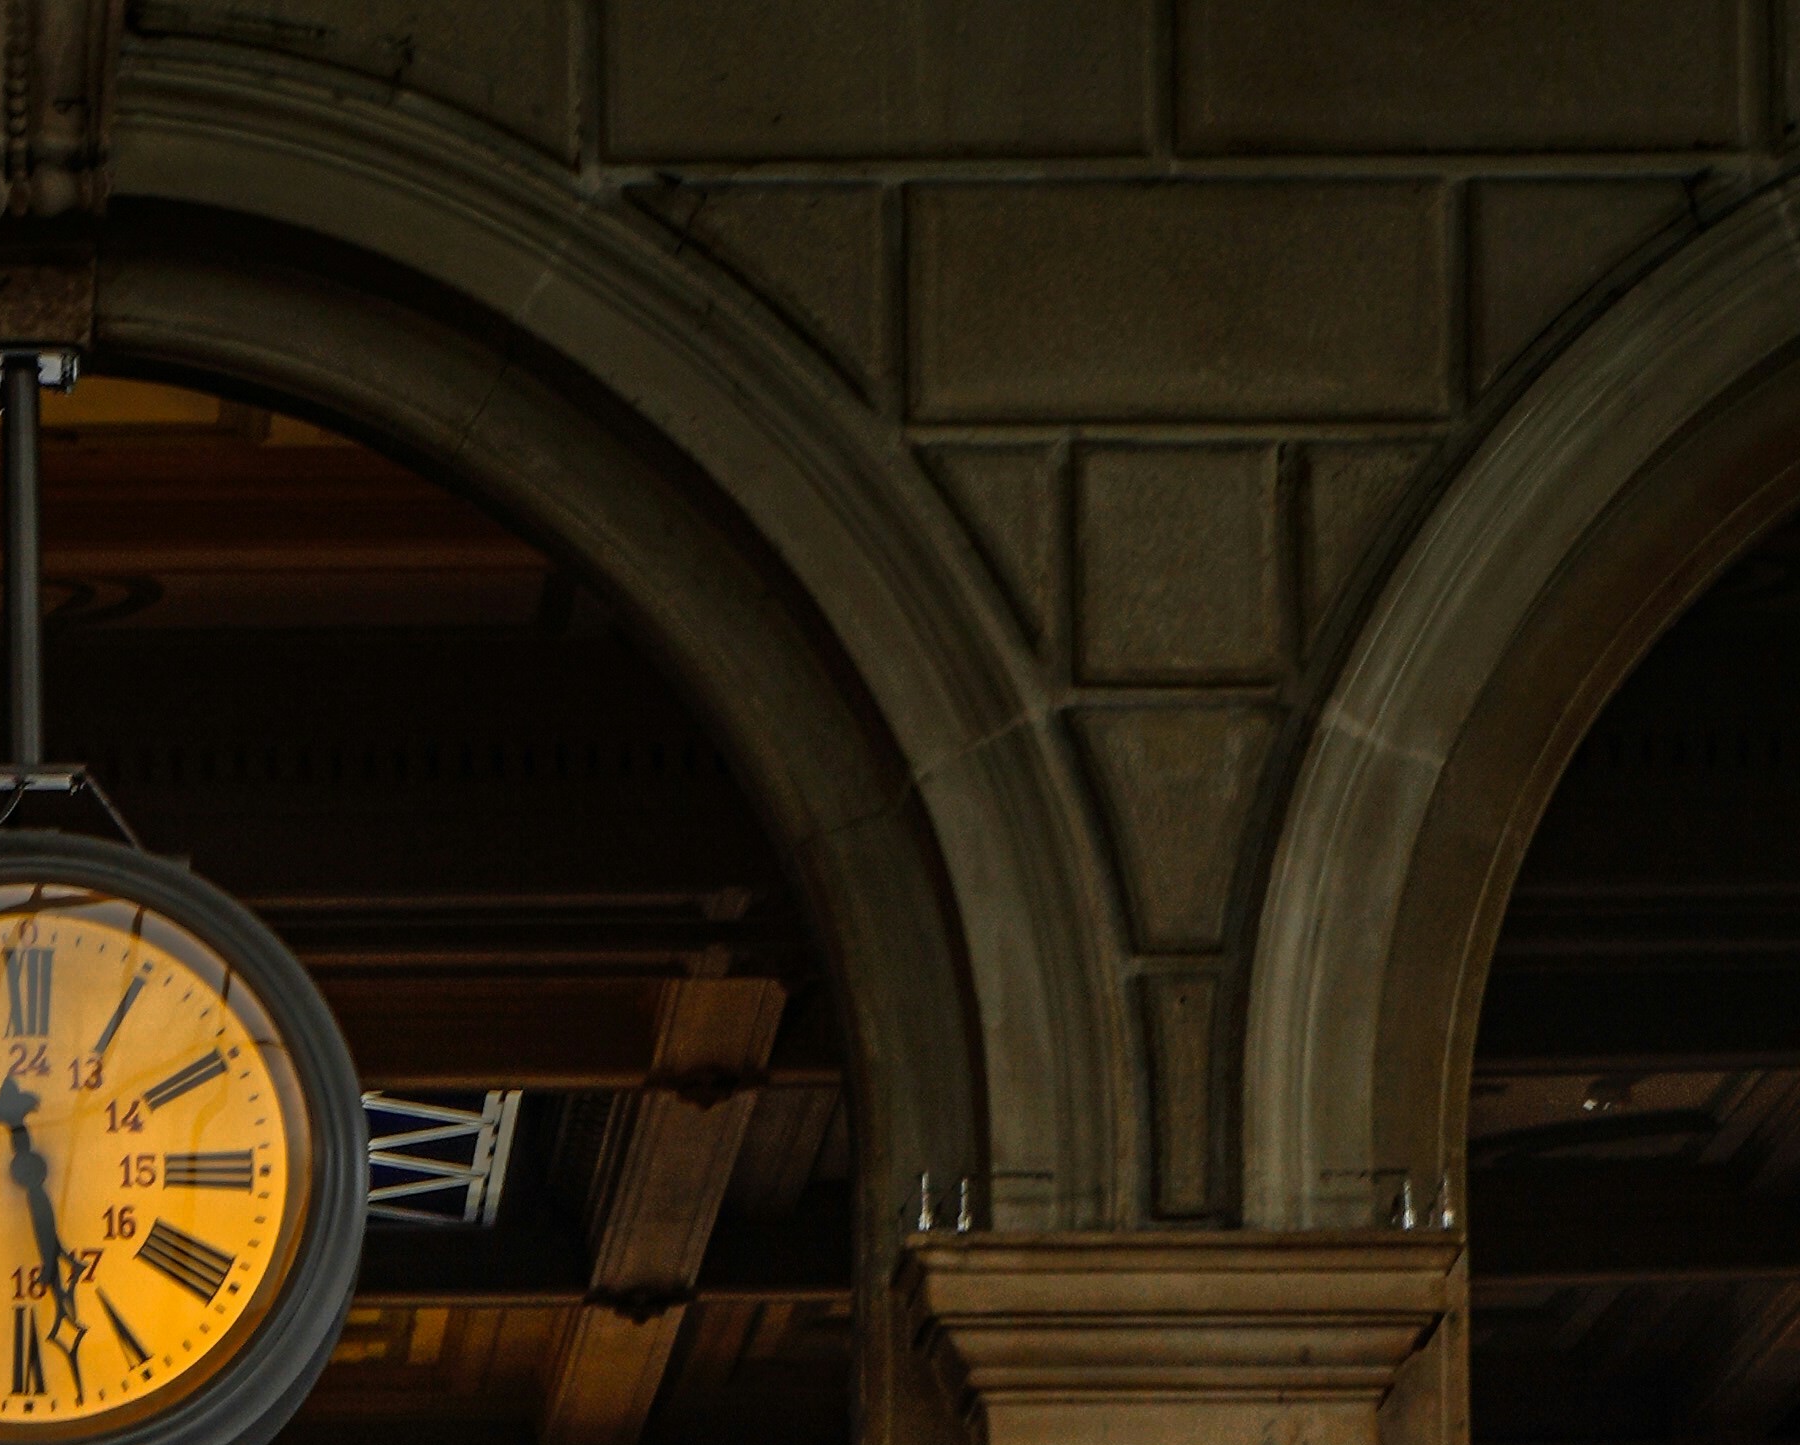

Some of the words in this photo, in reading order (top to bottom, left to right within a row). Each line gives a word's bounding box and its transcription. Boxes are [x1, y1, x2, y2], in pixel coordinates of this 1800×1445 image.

[9, 1044, 49, 1075] 24
[68, 1057, 104, 1091] 13
[105, 1099, 144, 1133] 14
[119, 1153, 157, 1188] 15
[102, 1205, 136, 1240] 16
[10, 1266, 47, 1300] 18
